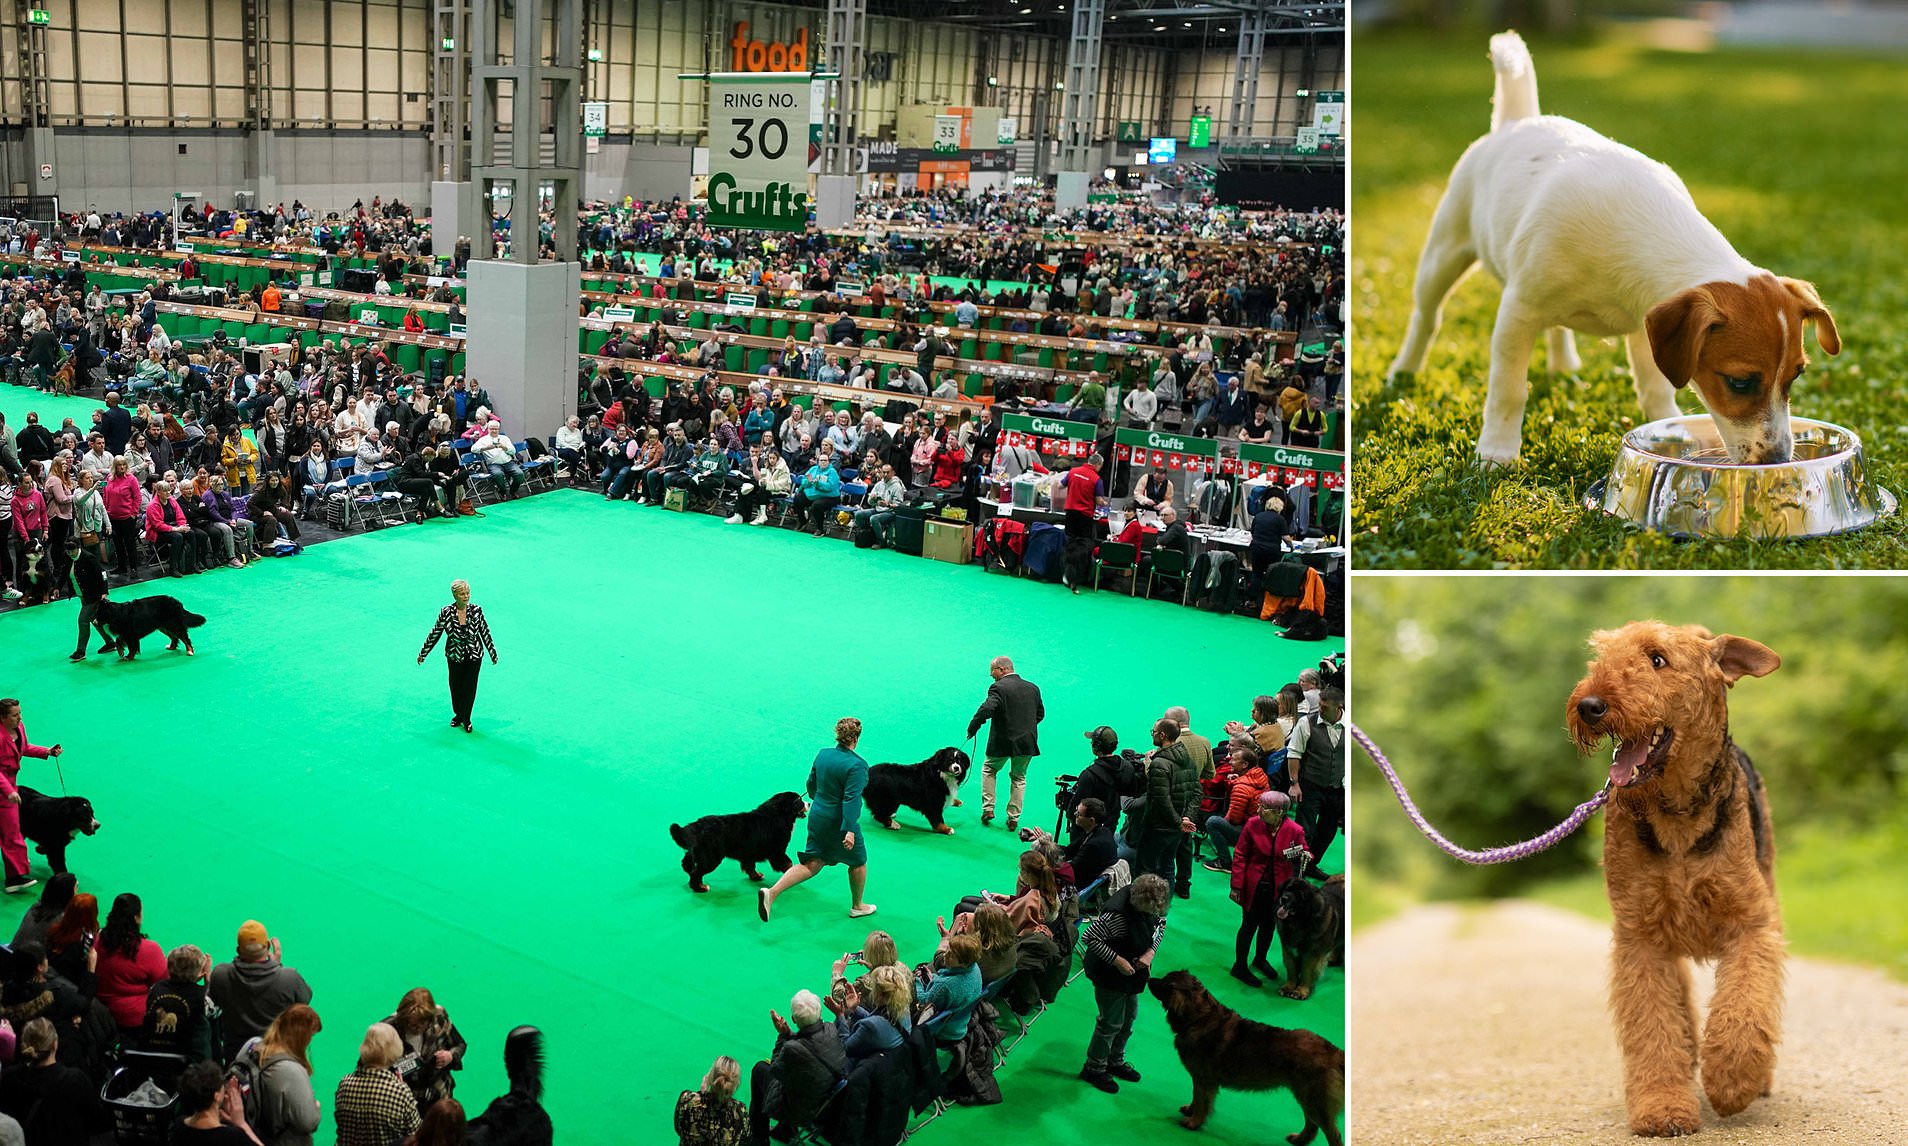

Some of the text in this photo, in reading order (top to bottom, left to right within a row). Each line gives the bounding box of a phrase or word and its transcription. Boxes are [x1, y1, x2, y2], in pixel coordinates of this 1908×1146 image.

[731, 21, 808, 72] food
[724, 93, 798, 108] RING NO.
[589, 112, 601, 123] 34
[729, 118, 788, 160] 30
[940, 126, 955, 138] 33
[1302, 135, 1314, 144] 35
[870, 141, 898, 155] MADE
[707, 172, 807, 219] Crufts
[1032, 418, 1065, 434] Crufts
[1148, 432, 1185, 450] Crufts
[1274, 449, 1313, 467] Crufts
